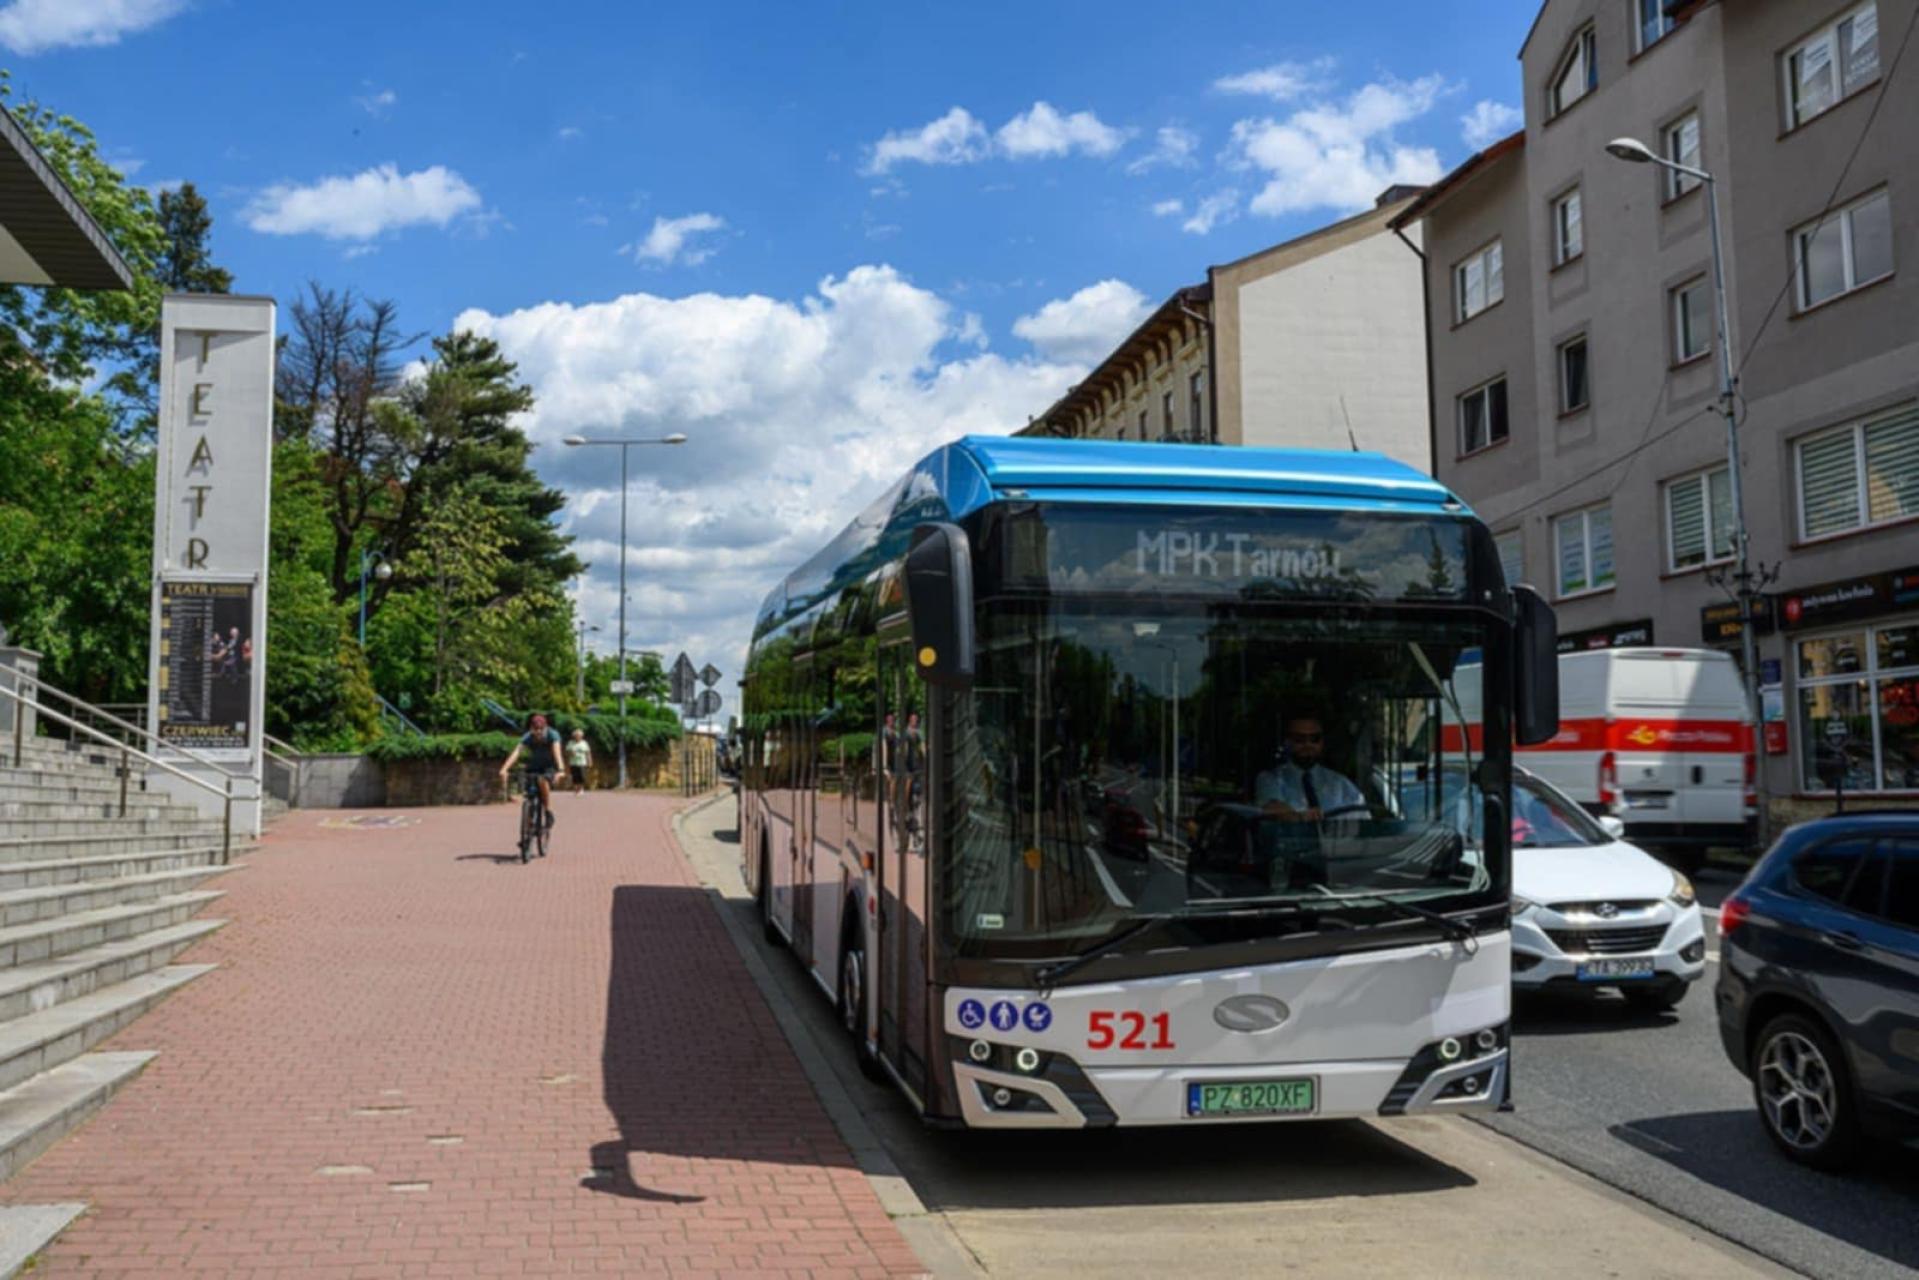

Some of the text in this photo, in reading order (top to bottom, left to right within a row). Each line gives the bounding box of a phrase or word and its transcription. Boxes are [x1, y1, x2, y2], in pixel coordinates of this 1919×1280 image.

[187, 330, 216, 571] TEATR
[1136, 530, 1219, 576] MPK
[167, 583, 210, 595] TEATR
[163, 725, 230, 737] CZERWIEC
[1087, 1011, 1176, 1050] 521
[1203, 1084, 1307, 1109] PZ 820XF
